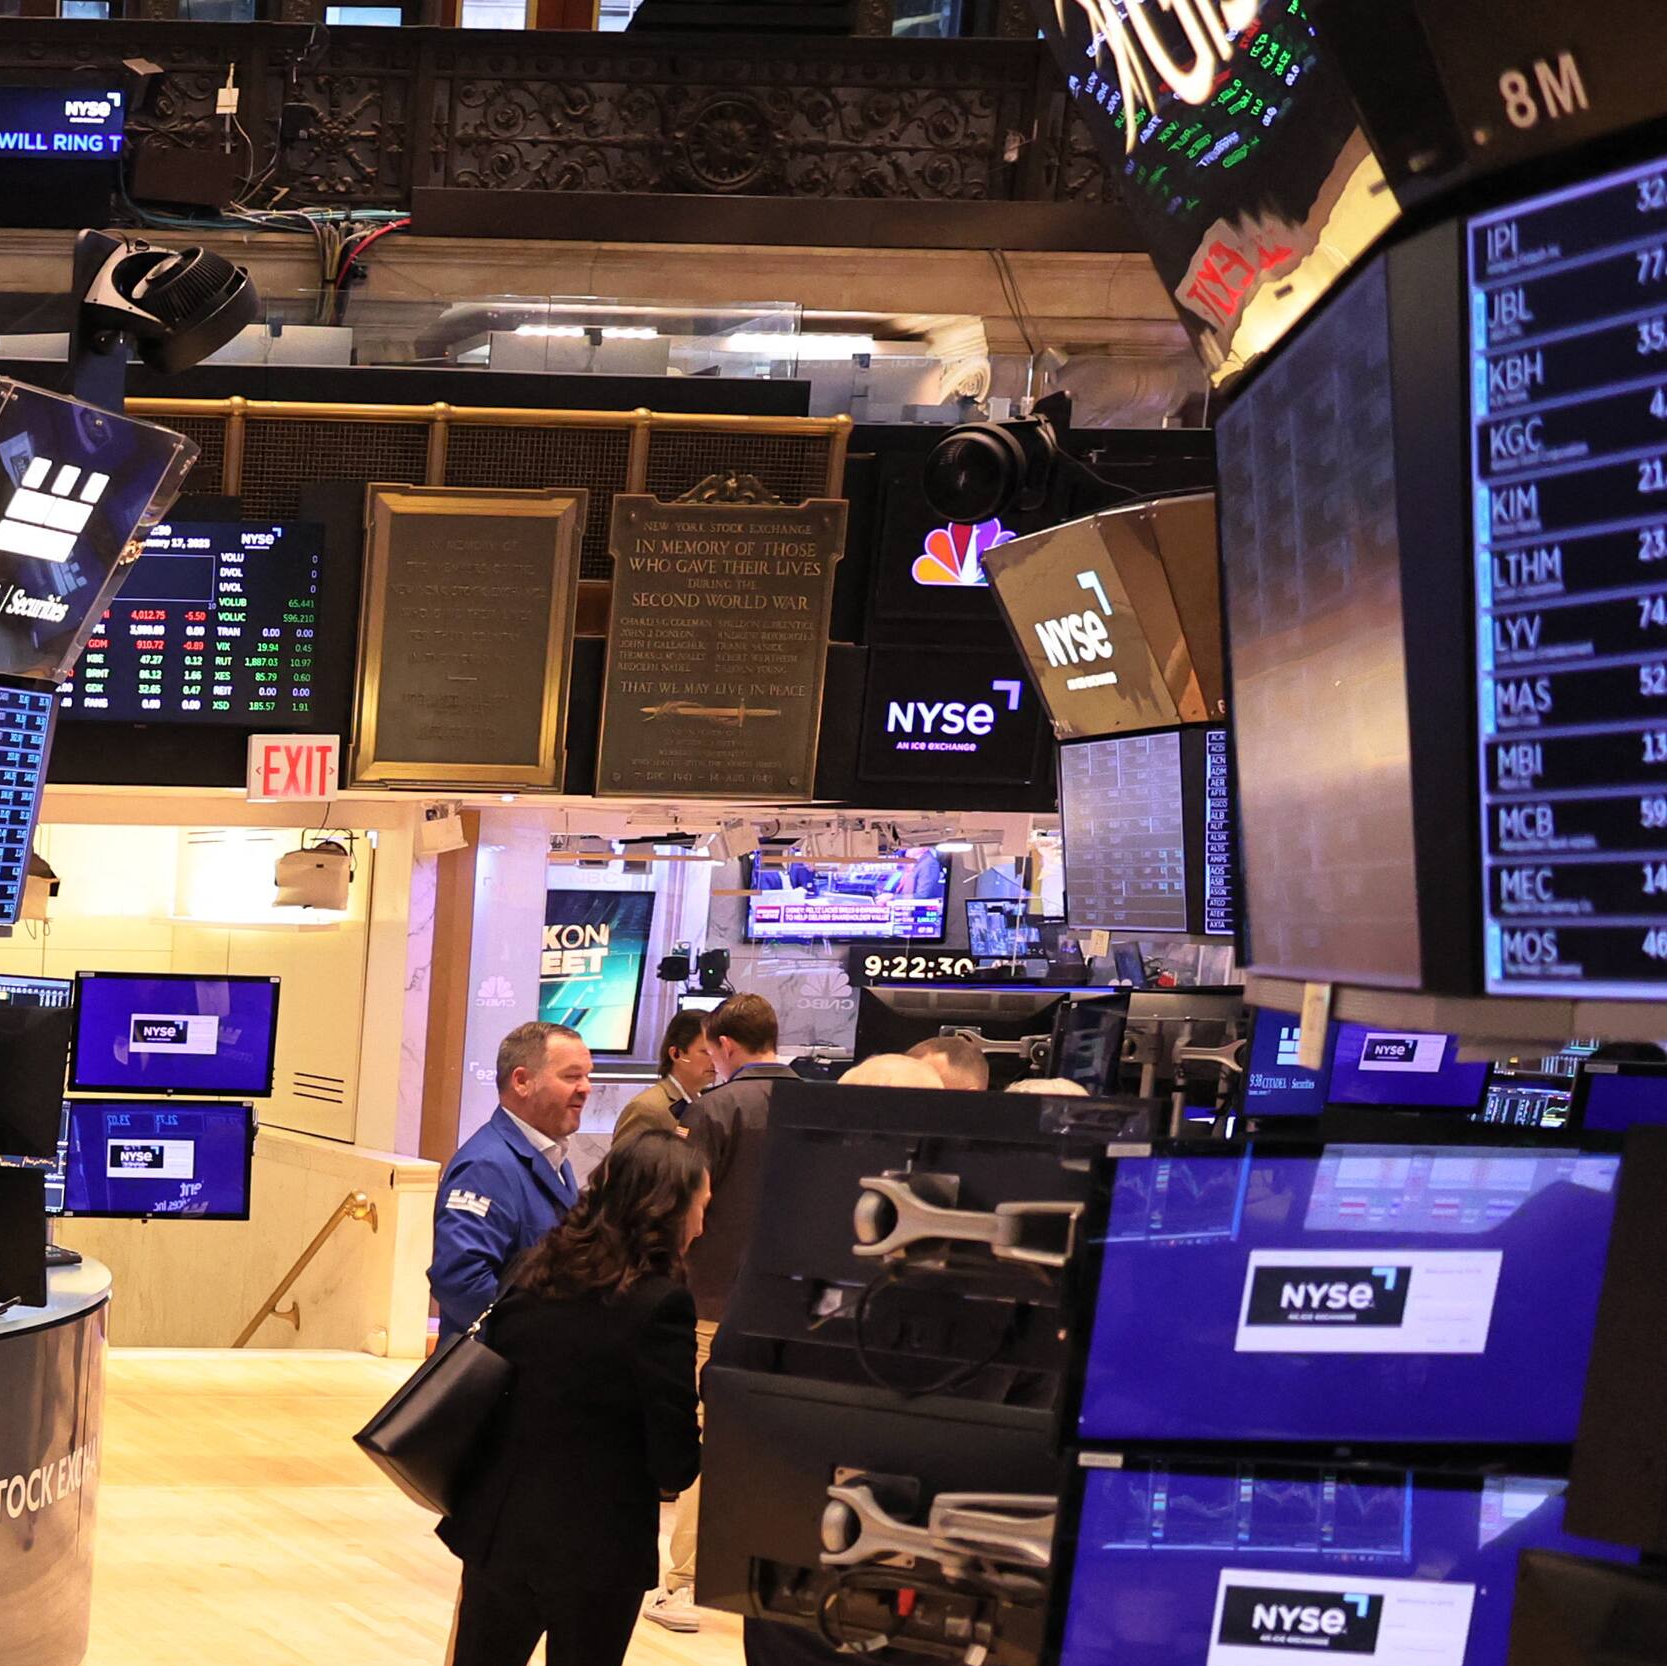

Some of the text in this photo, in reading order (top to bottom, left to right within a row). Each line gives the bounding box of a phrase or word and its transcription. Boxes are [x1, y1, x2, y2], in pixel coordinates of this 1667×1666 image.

[54, 134, 103, 151] RING
[1484, 222, 1520, 262] IPI
[1487, 289, 1535, 328] JBL
[1487, 353, 1545, 396] KBH
[1488, 420, 1546, 461] KGC
[1489, 487, 1540, 521] KIM
[644, 523, 812, 534] NEW YORK STOCK EXCHANGE
[636, 540, 817, 557] IN MEMORY OF THOSE
[630, 559, 821, 575] WHO GAVE THEIR LIVES
[1491, 546, 1563, 588] LTHM
[7, 589, 69, 621] Securities
[632, 594, 809, 609] SECOND WORLD WAR
[1493, 616, 1543, 652] LYV
[621, 682, 652, 692] THAT
[684, 684, 710, 694] MAY
[716, 685, 744, 694] LIVE
[769, 686, 806, 695] PEACE
[1497, 678, 1553, 713] MAS
[265, 745, 332, 796] EXIT
[1498, 744, 1543, 778] MBI
[1499, 808, 1555, 841] MCB
[1499, 868, 1554, 901] MEC
[1502, 929, 1559, 964] MOS
[863, 953, 973, 980] 9:22:30
